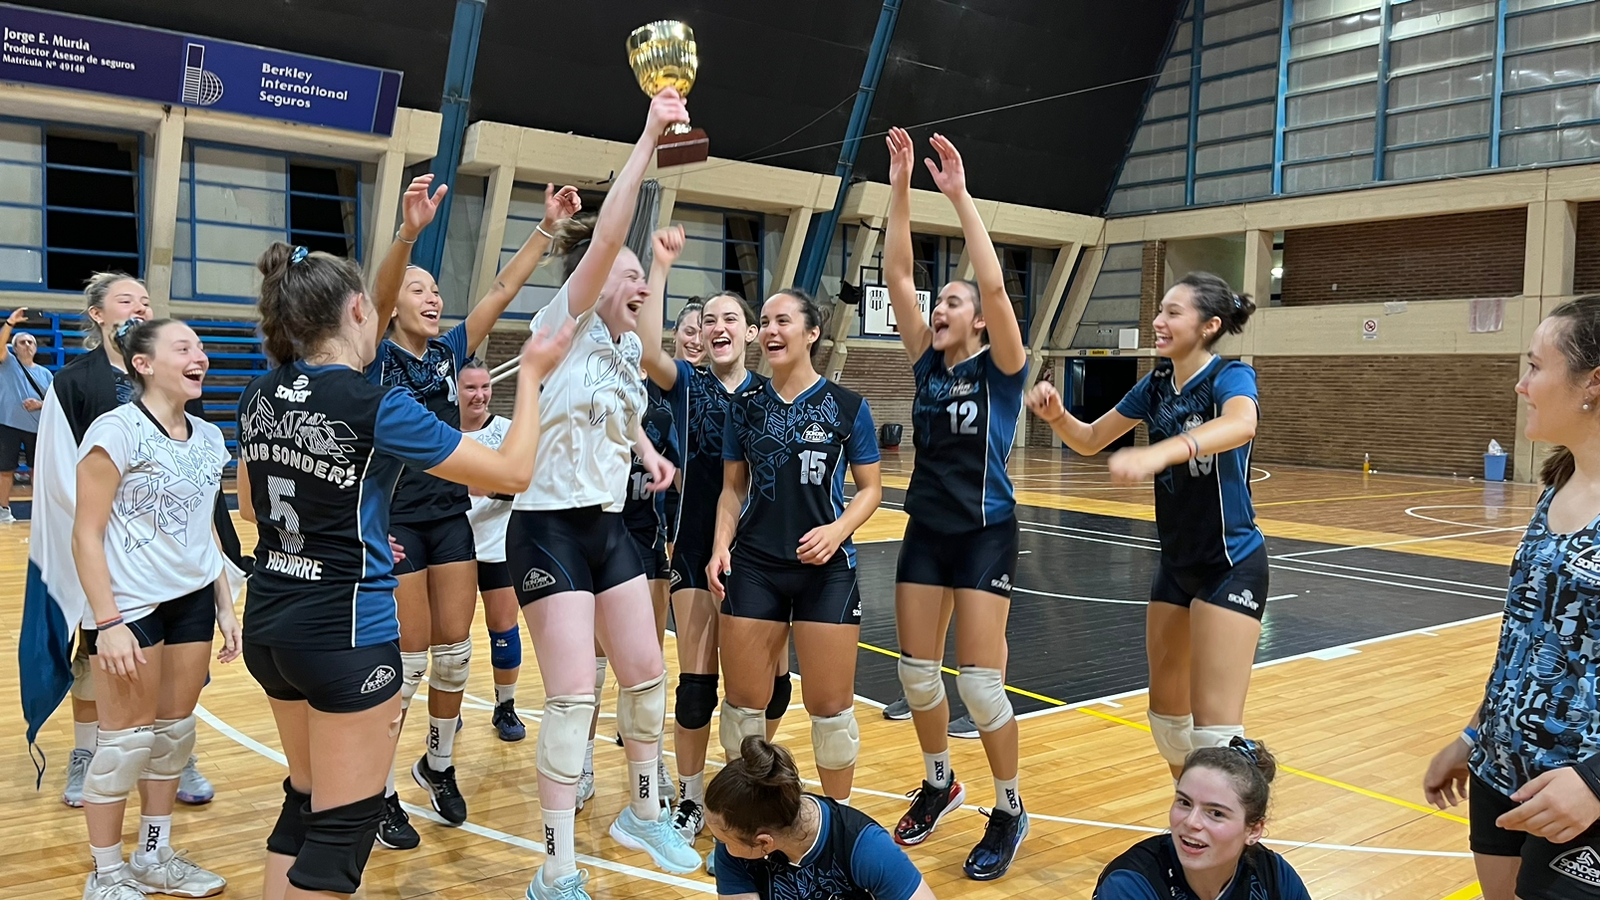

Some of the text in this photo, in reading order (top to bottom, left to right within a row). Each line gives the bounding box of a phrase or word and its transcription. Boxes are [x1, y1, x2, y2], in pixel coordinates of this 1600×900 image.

[4, 27, 35, 44] Jorge
[38, 32, 49, 45] E.
[2, 53, 42, 68] Matrícula
[59, 62, 85, 74] 49148
[3, 42, 136, 70] Productor Asesor de seguros
[261, 62, 312, 84] Berkley
[259, 90, 311, 108] Seguros
[261, 77, 348, 100] International
[946, 400, 978, 434] 12
[271, 444, 346, 484] SONDER
[797, 449, 828, 485] 15
[266, 474, 306, 554] 5
[265, 550, 324, 581] AGUIRRE
